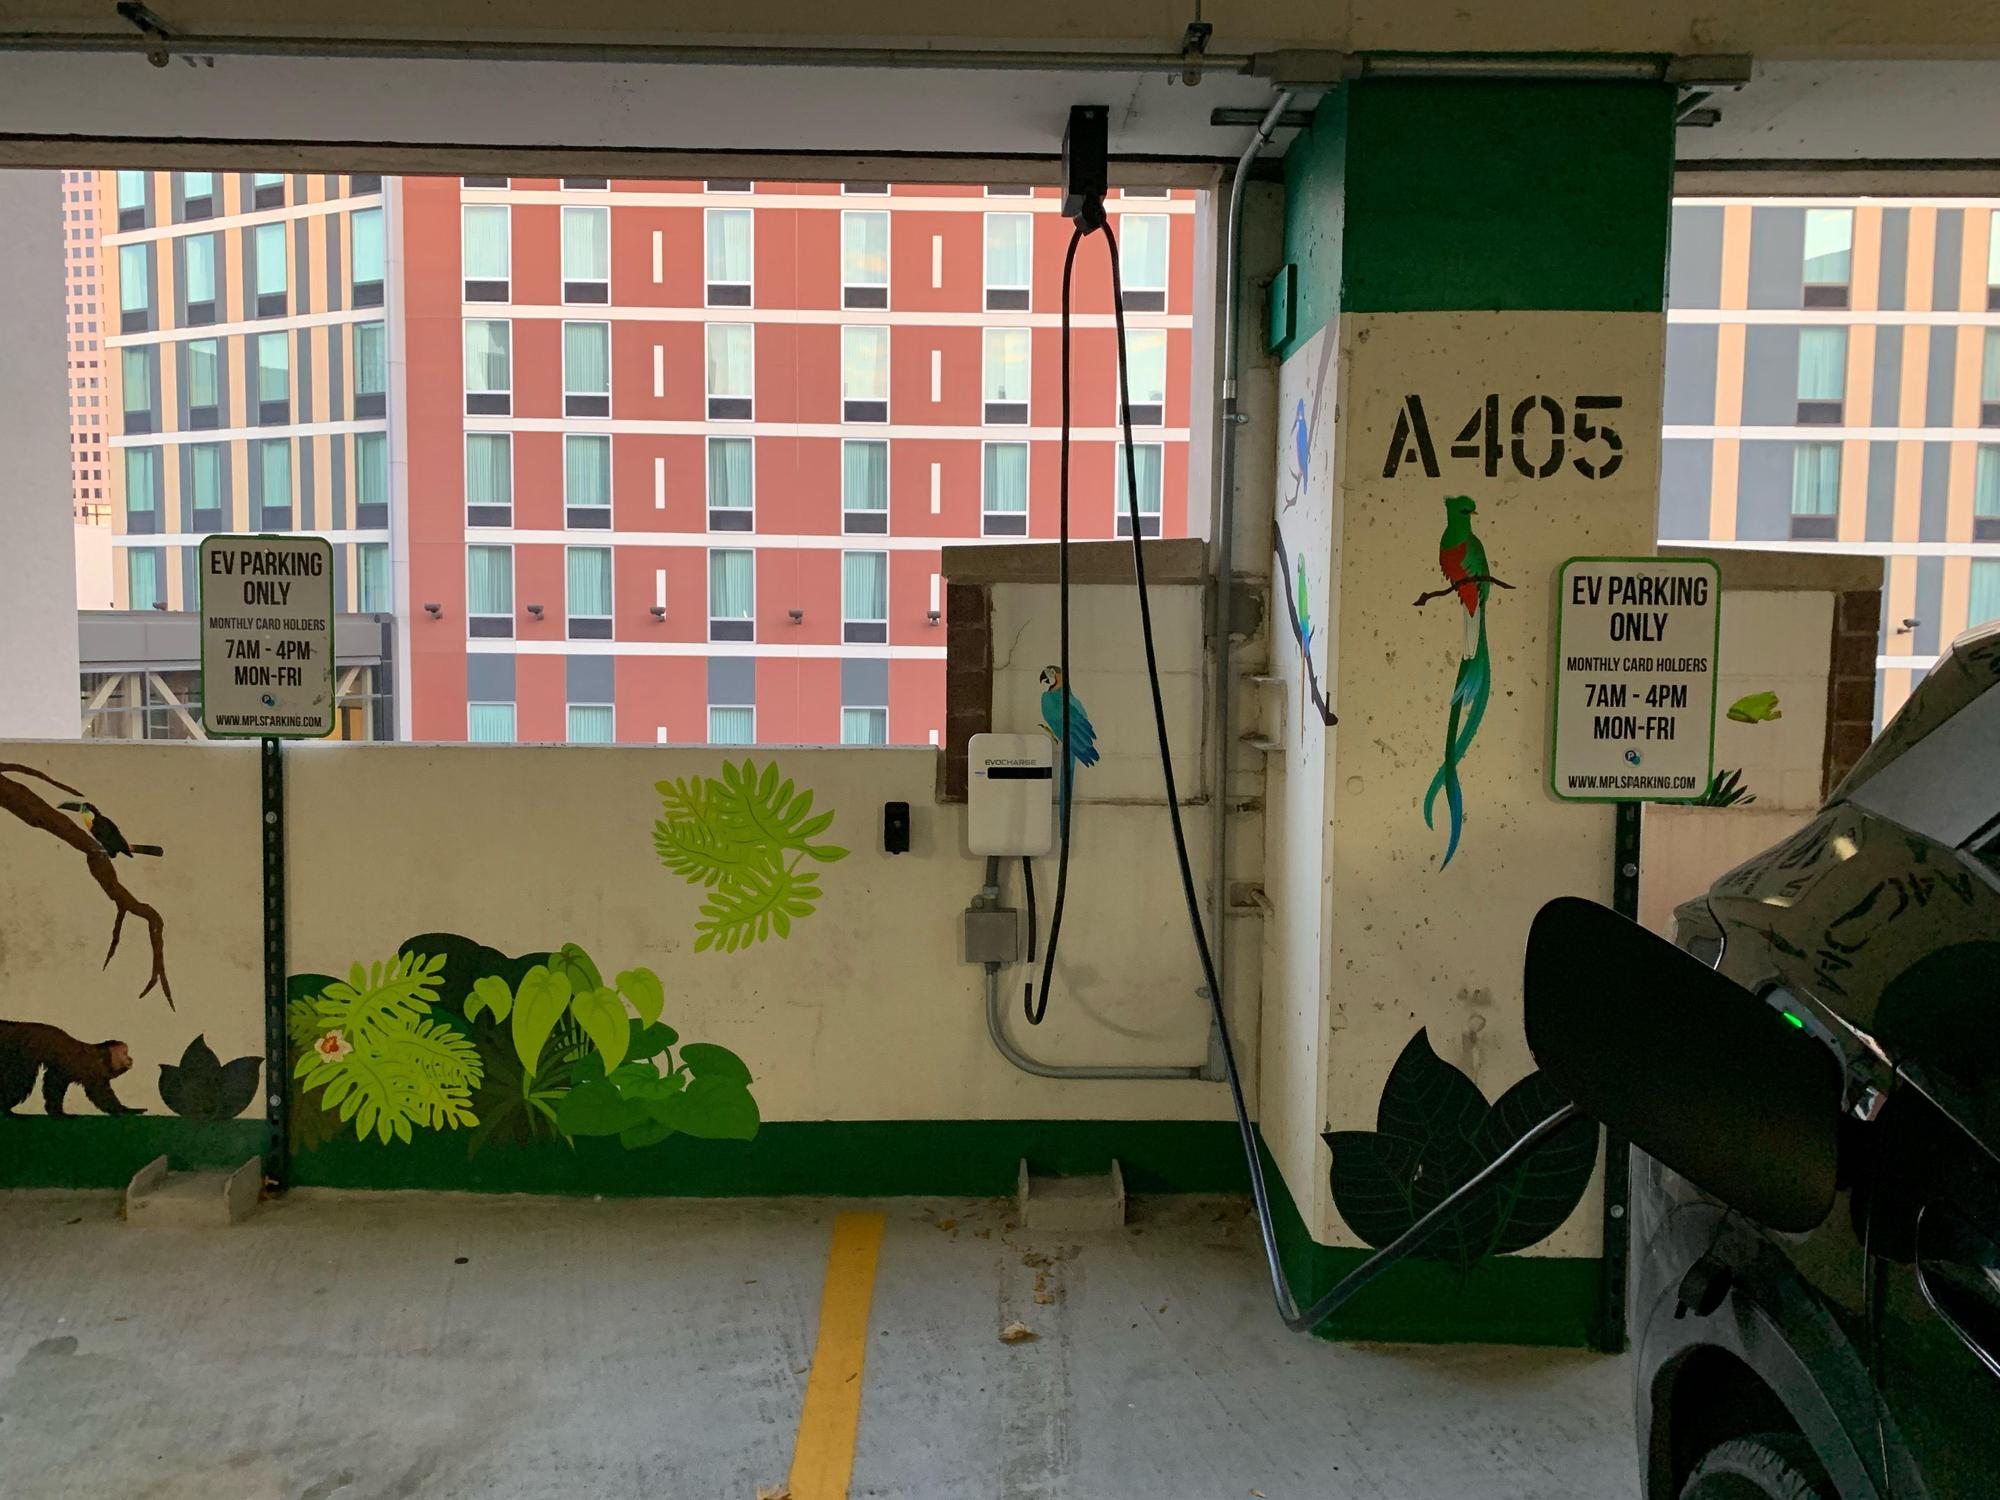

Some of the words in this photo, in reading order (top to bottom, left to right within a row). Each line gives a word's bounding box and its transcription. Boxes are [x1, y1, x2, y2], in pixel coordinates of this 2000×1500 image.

[211, 551, 234, 574] EV
[241, 552, 322, 576] PARKING
[244, 581, 291, 605] ONLY
[1572, 576, 1602, 605] EV
[1608, 576, 1708, 606] PARKING
[210, 618, 253, 630] MONTHLY
[256, 619, 280, 630] CARD
[283, 620, 326, 631] HOLDERS
[1610, 612, 1668, 642] ONLY
[226, 640, 260, 659] 7AM
[276, 642, 310, 660] 4PM
[235, 666, 302, 686] MON-FRI
[1567, 658, 1618, 672] MONTHLY
[1624, 658, 1653, 672] CARD
[1656, 658, 1708, 672] HOLDERS
[1585, 684, 1626, 707] 7AM
[1646, 686, 1686, 708] 4PM
[1594, 716, 1674, 740] MON-FRI
[1568, 776, 1695, 789] WWW.MPLSPARKING.COM
